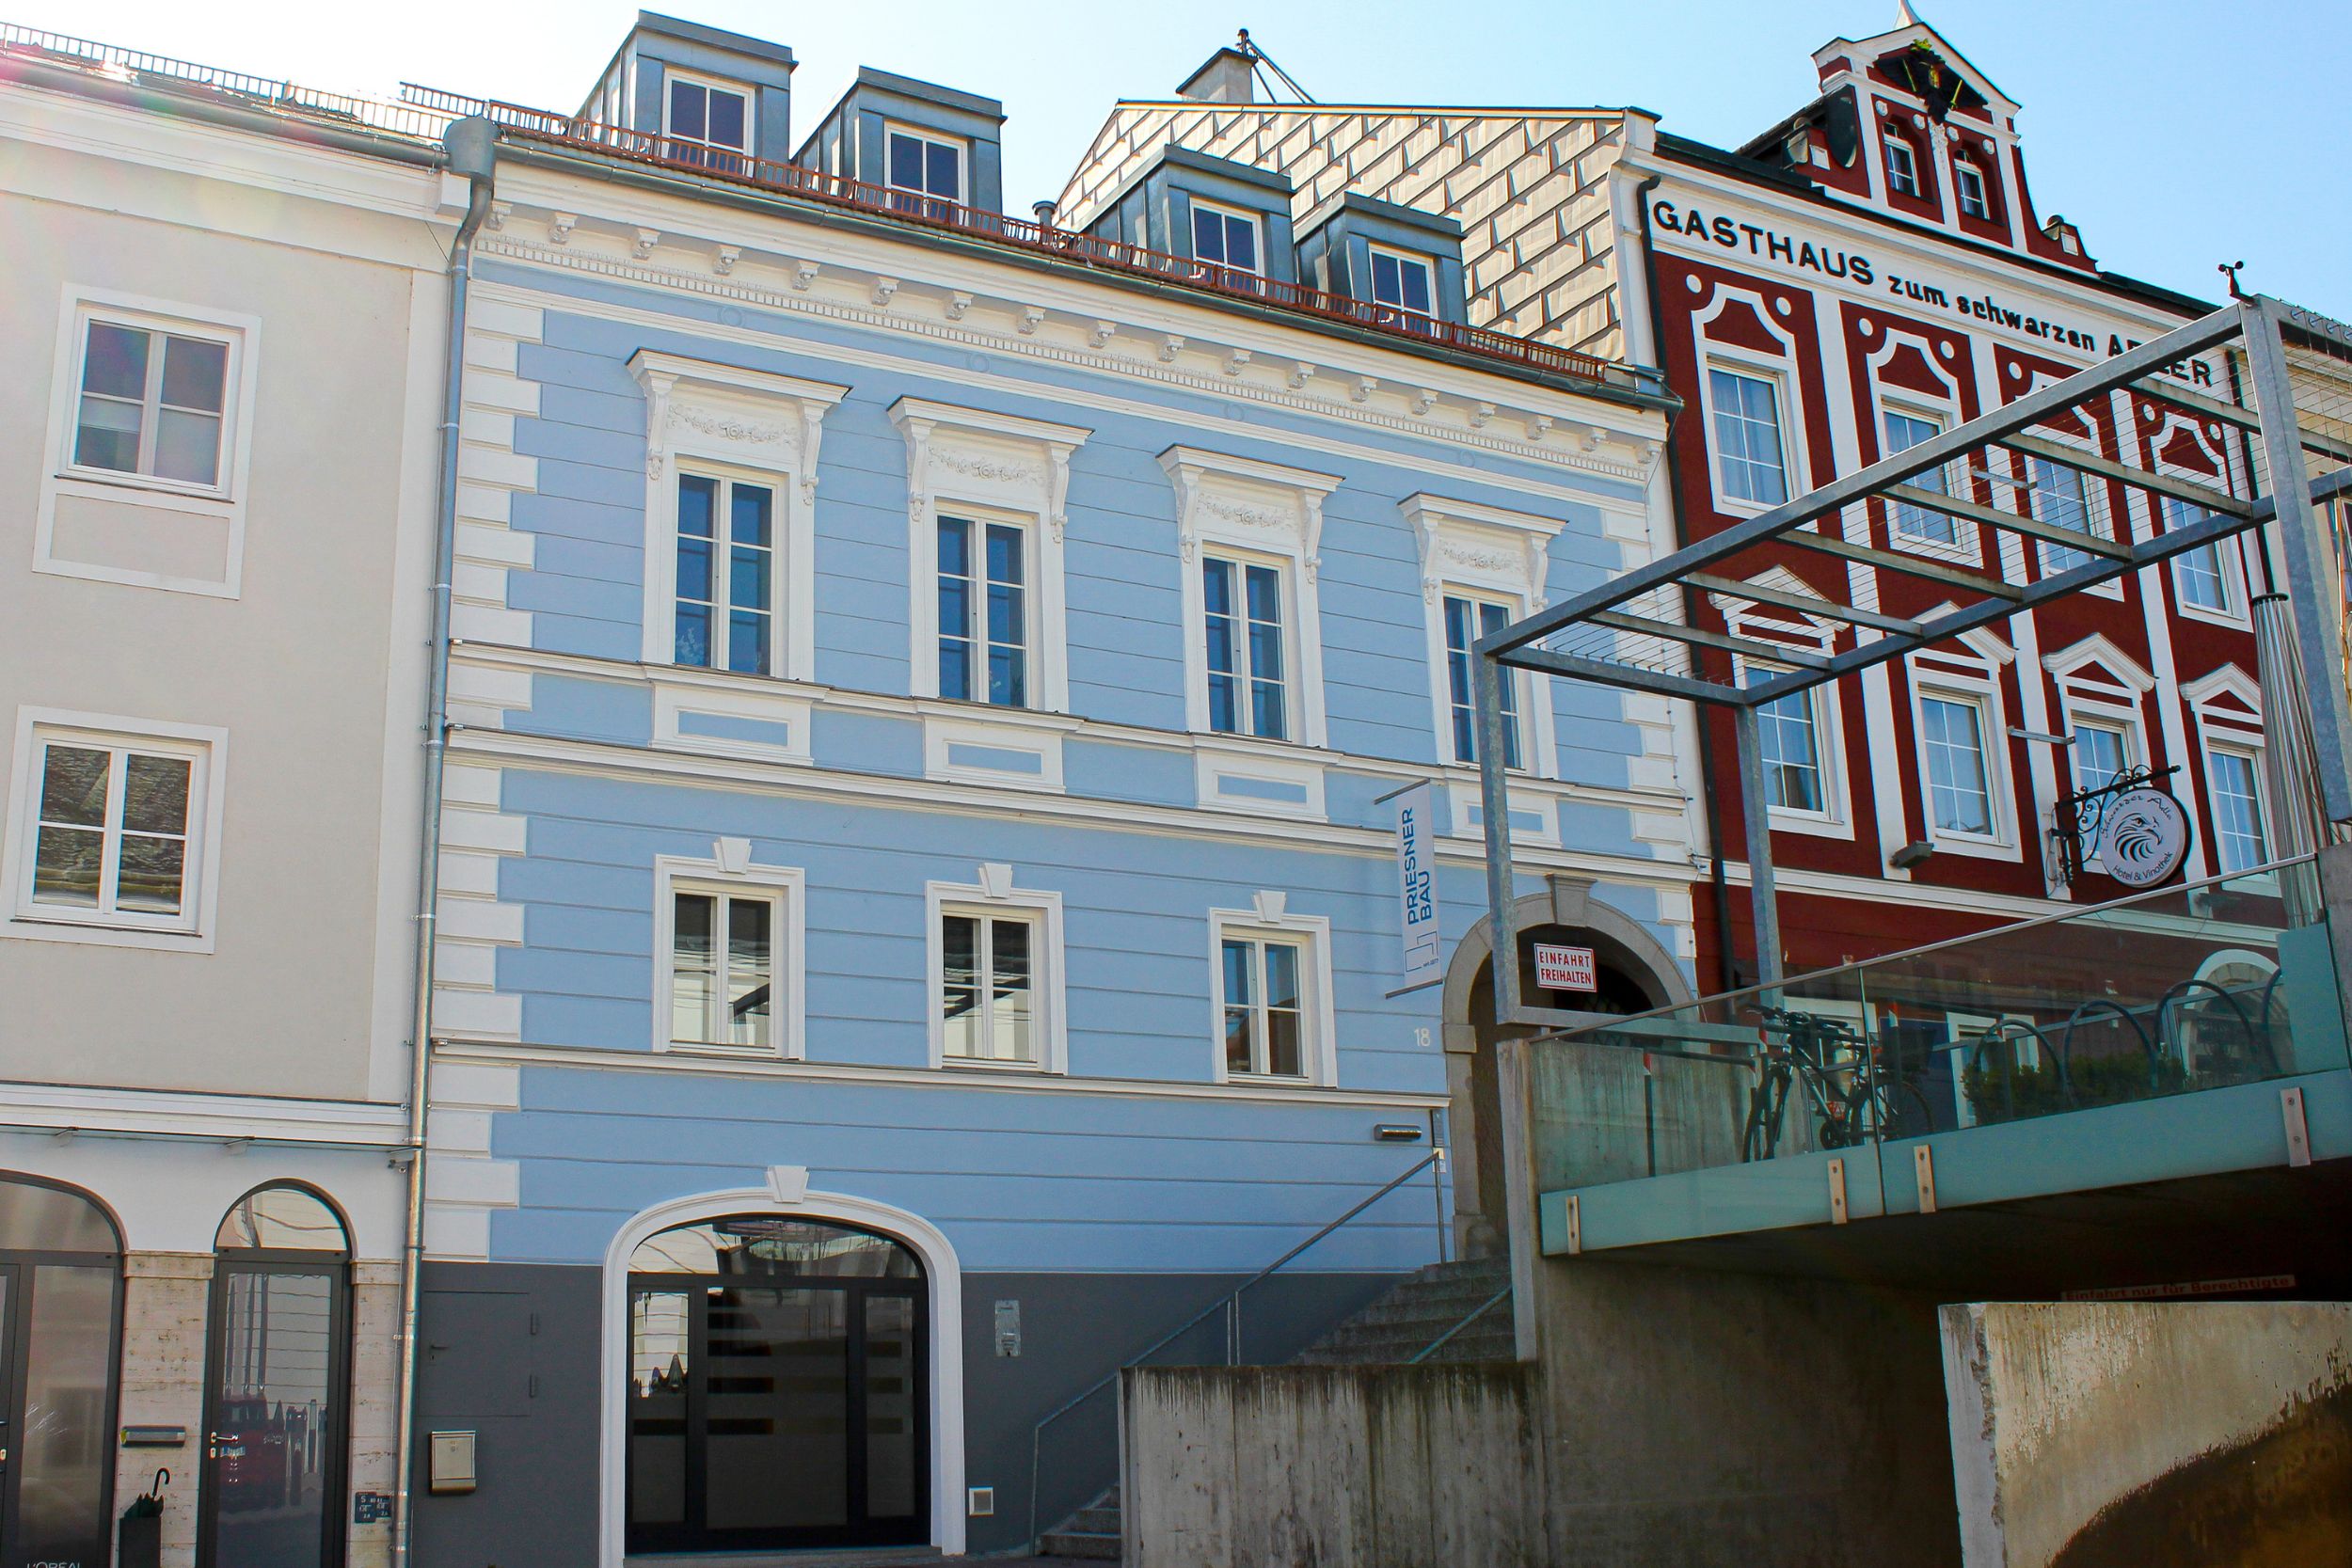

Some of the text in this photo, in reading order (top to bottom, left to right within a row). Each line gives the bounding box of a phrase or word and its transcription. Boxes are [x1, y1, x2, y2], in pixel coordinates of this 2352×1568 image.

[1653, 200, 2212, 388] GASTHAUS zum schwarzen AER
[1402, 806, 1419, 925] PRIESNER
[2113, 864, 2132, 880] Hotel
[2142, 851, 2173, 879] Vinothek
[1418, 870, 1432, 921] BAU
[1539, 951, 1590, 968] EINFAHRT
[1541, 968, 1592, 984] FREIHALTEN
[1414, 1027, 1431, 1047] 18
[2132, 1287, 2156, 1297] nur
[2190, 1277, 2289, 1292] Berechtigte
